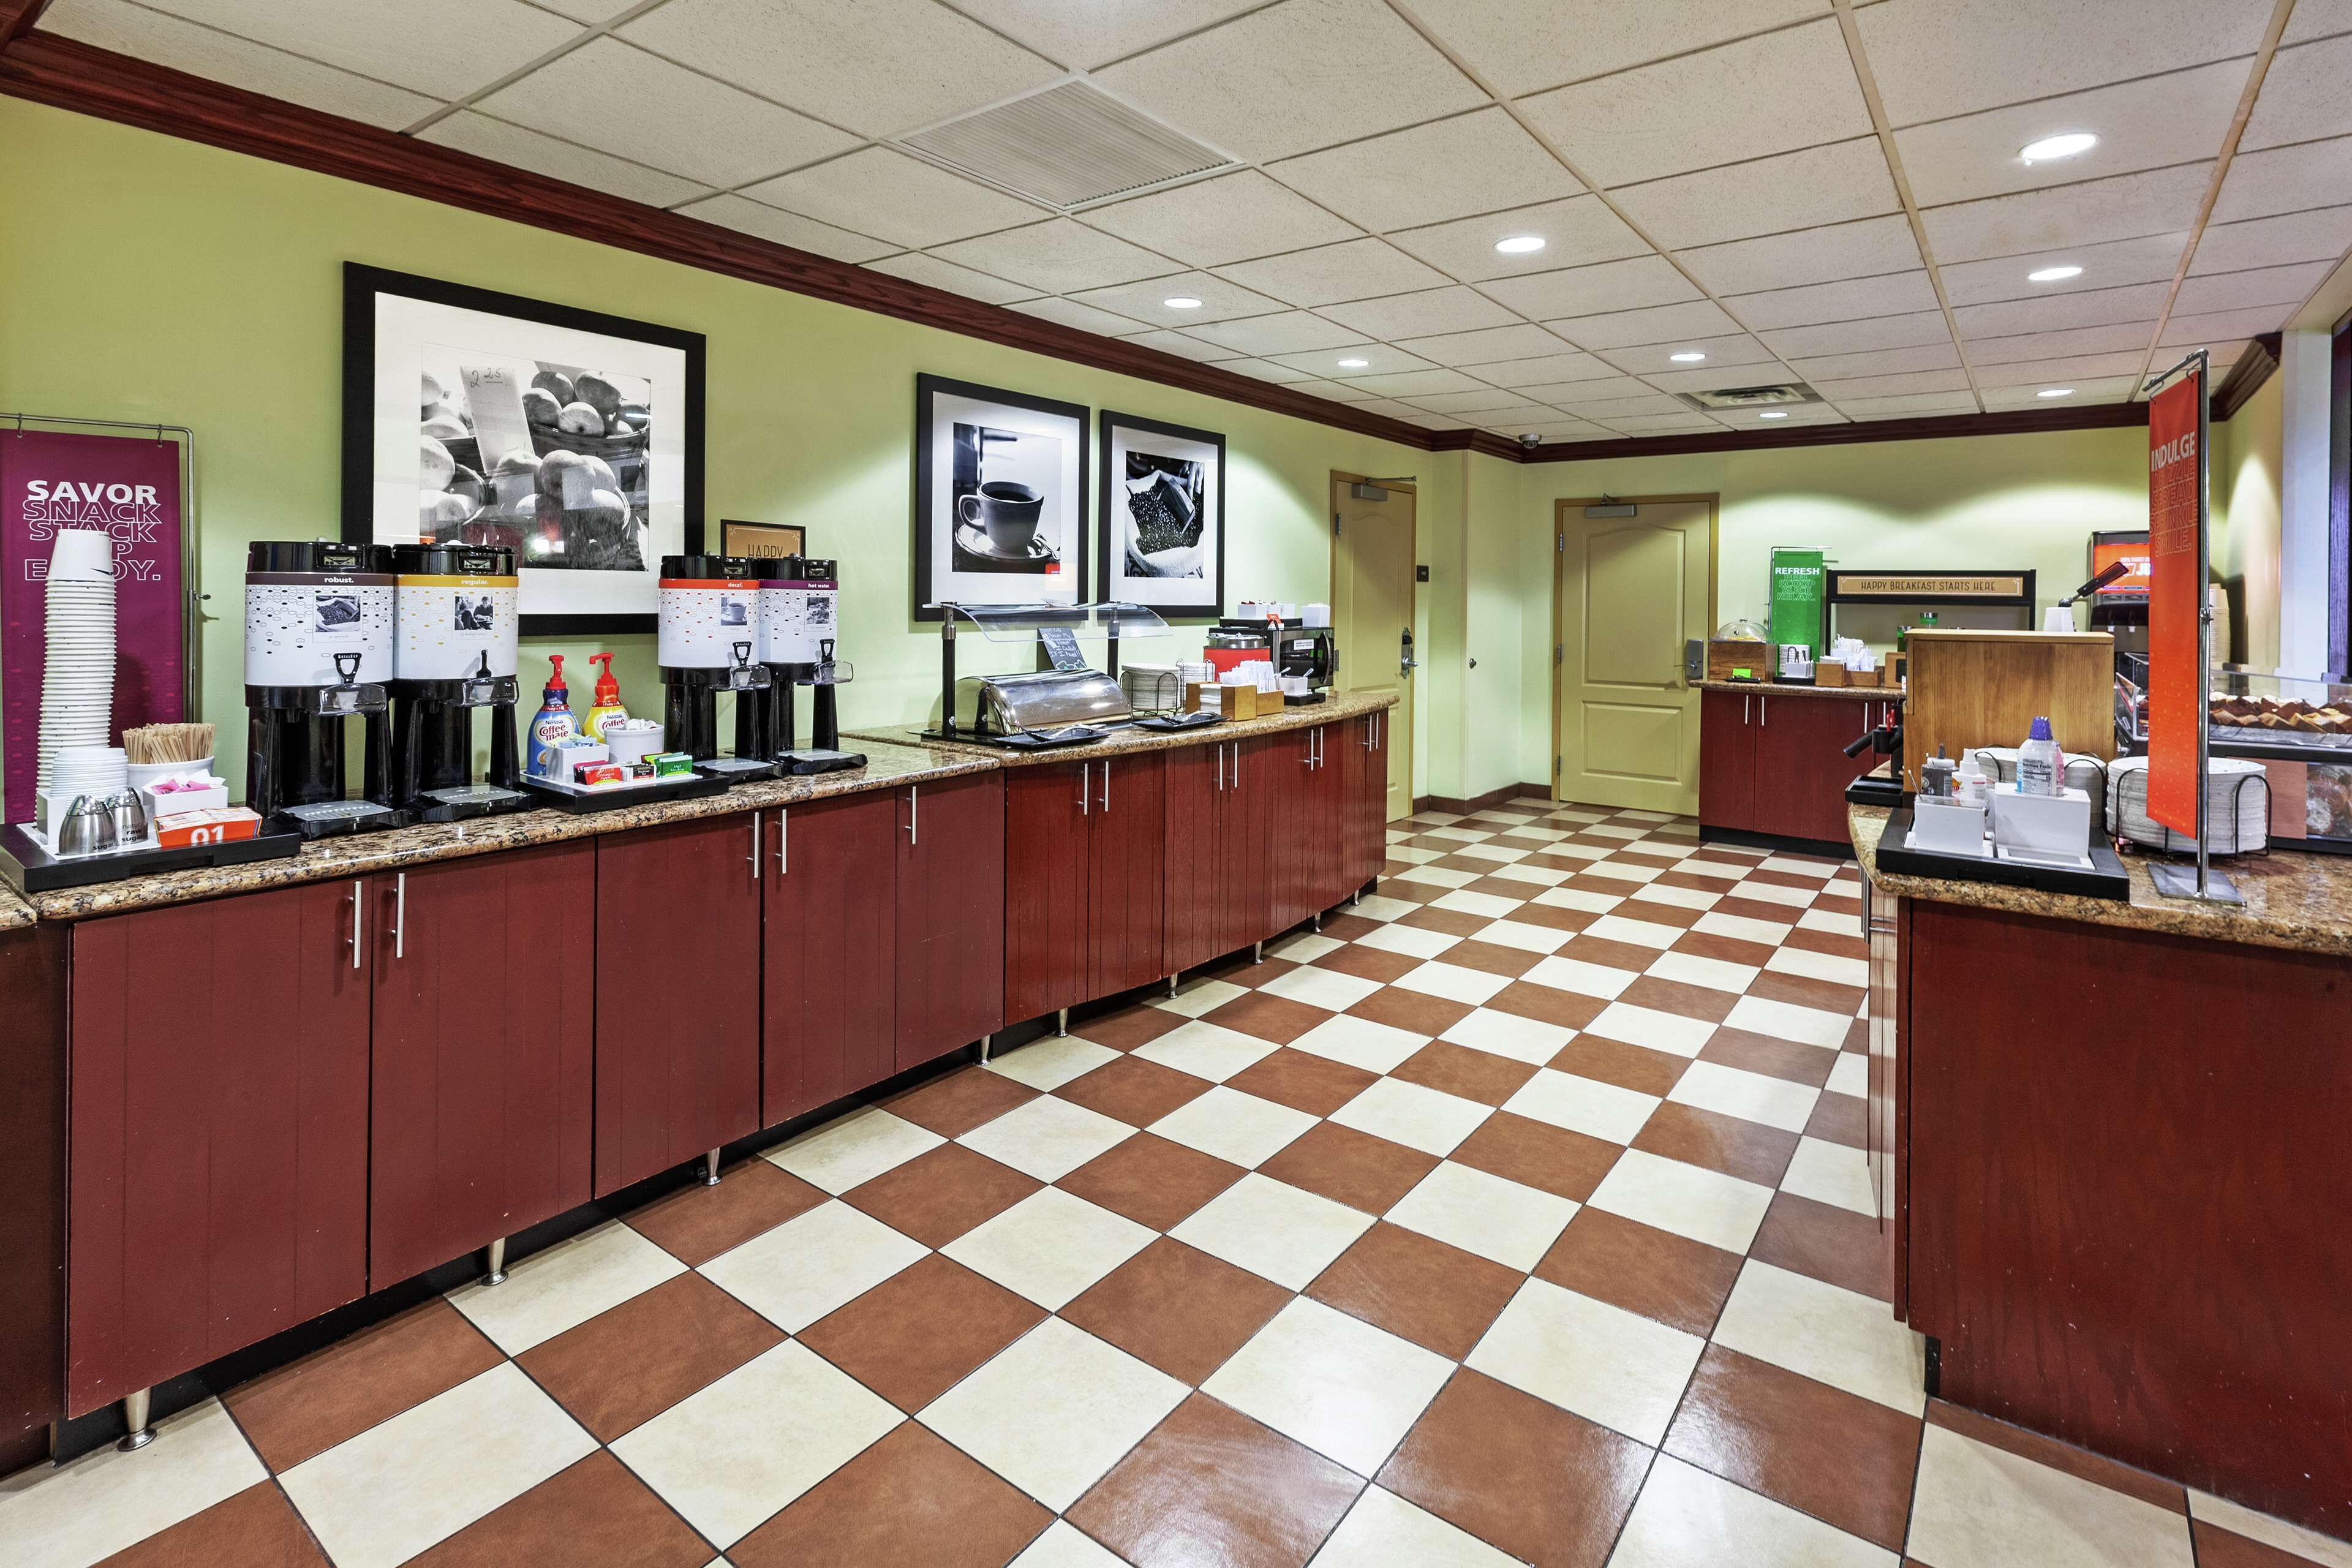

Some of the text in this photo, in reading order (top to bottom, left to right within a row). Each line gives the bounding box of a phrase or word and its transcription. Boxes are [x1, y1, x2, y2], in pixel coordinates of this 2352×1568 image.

[2150, 431, 2196, 472] INDULGE
[2152, 457, 2196, 491] DRIZZLE
[26, 480, 157, 505] SAVOR
[2151, 479, 2196, 514] SPREAD
[22, 499, 163, 524] SNACK
[2149, 499, 2198, 538] SPRINKLE
[747, 543, 784, 559] HAPPY
[1774, 567, 1820, 575] REFRESH
[1778, 578, 1816, 589] SCOOP
[1781, 586, 1812, 595] SLICE
[1861, 581, 1996, 592] HAPPY BREAKFAST STARTS HERE
[539, 725, 566, 737] Coffee
[602, 718, 625, 730] Coffee
[92, 842, 114, 851] sugar
